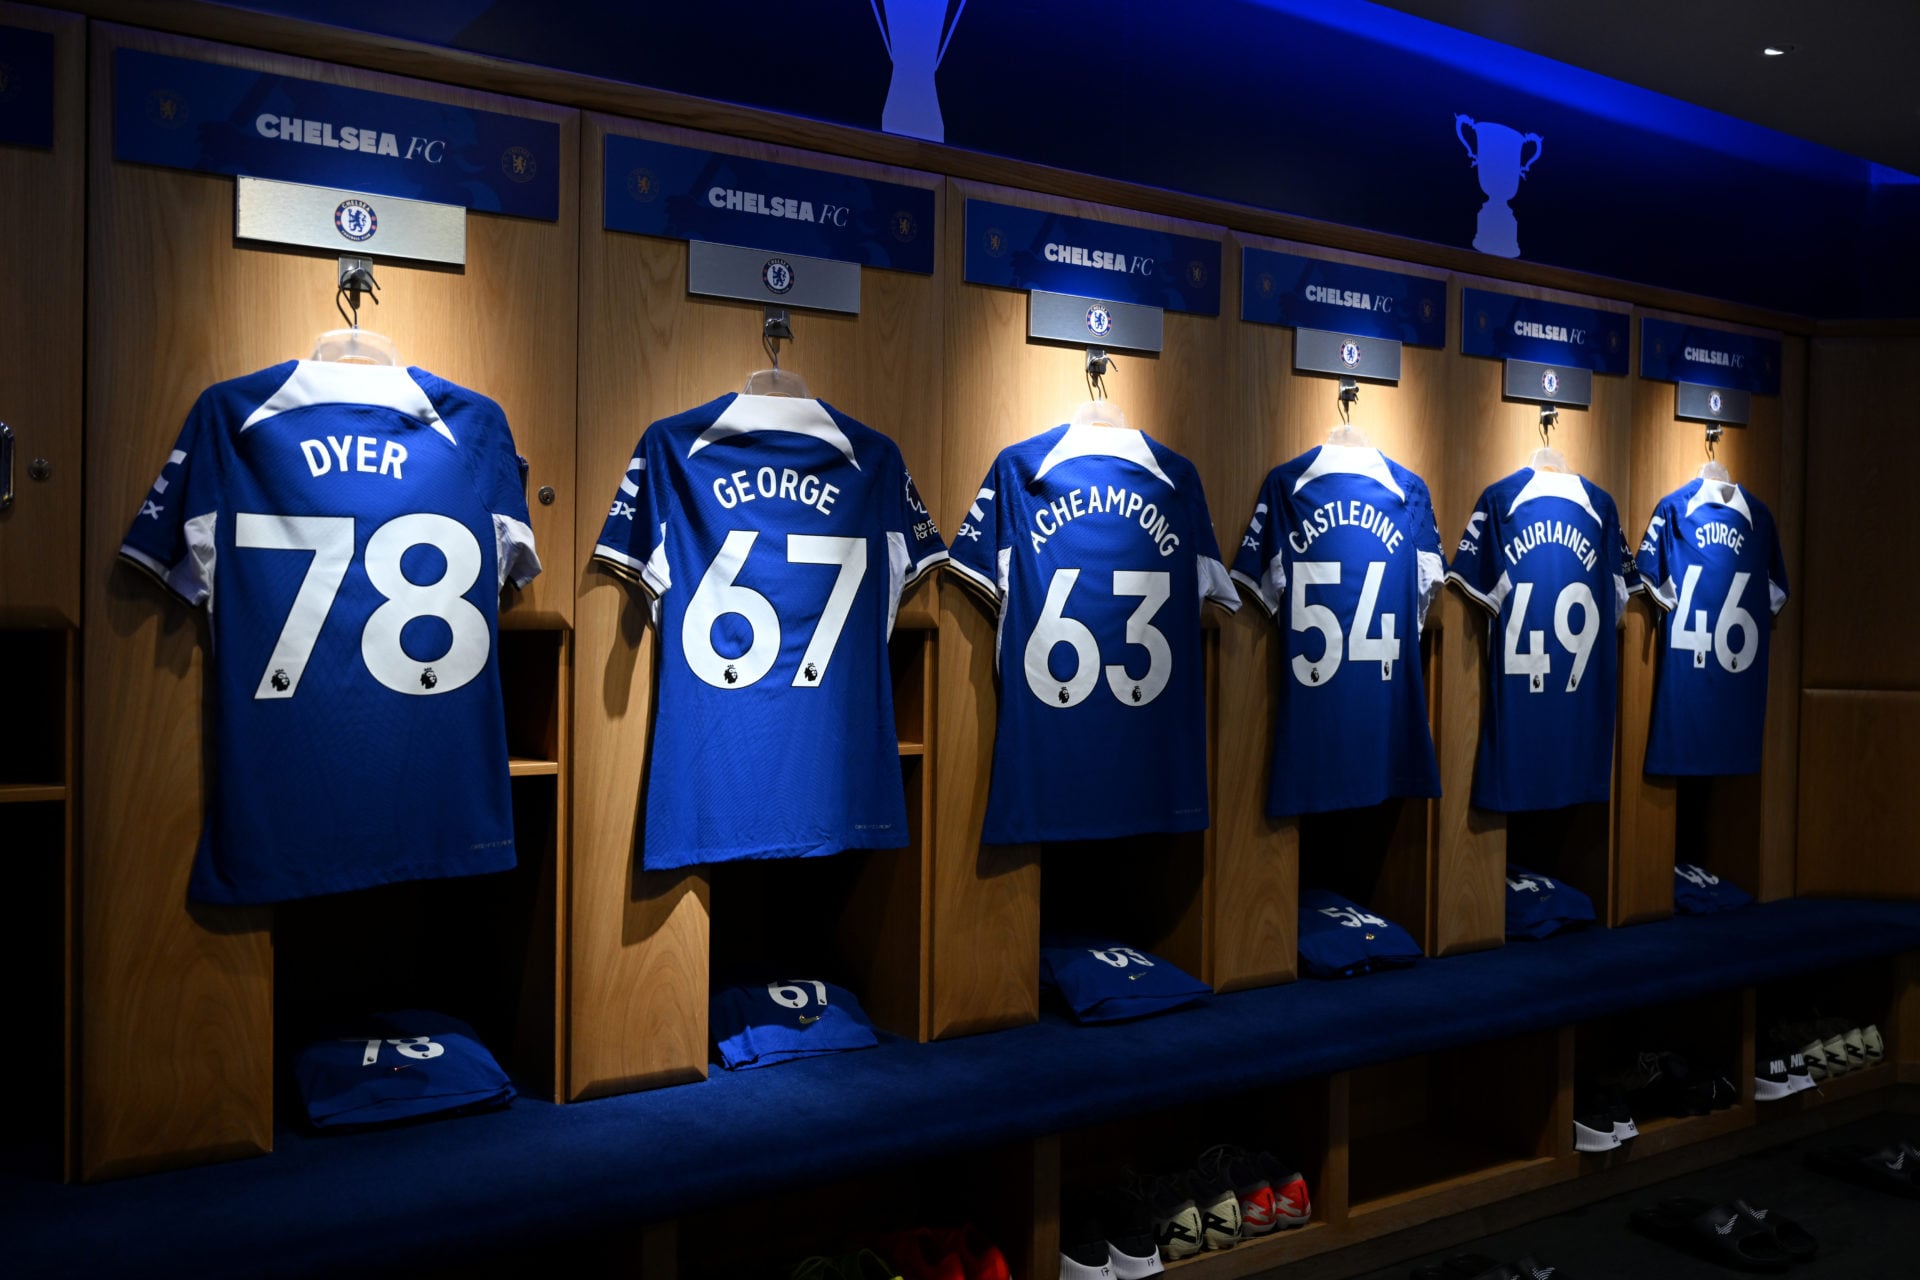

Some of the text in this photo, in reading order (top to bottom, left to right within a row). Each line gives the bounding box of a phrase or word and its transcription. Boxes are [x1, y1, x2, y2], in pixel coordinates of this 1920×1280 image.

[255, 113, 446, 164] CHELSEA FC
[708, 186, 850, 228] CHELSEA FC
[1044, 242, 1154, 277] CHELSEA FC
[1305, 285, 1393, 314] CHELSEA FC
[1514, 320, 1585, 345] CHELSEA FC
[1684, 346, 1729, 367] CHELSEA
[300, 435, 408, 480] DYER
[712, 466, 840, 516] GEORGE
[1030, 485, 1180, 558] ACHEAMPONG
[1288, 500, 1405, 554] CASTLEDINE
[1504, 520, 1598, 573] TAURIAINEN
[1695, 522, 1745, 555] STURGE
[235, 512, 491, 700] 78
[682, 530, 868, 690] 67
[1291, 561, 1401, 687] 54
[1670, 564, 1759, 673] 46
[1024, 568, 1173, 708] 63
[1504, 581, 1601, 694] 49
[1317, 906, 1389, 928] 54
